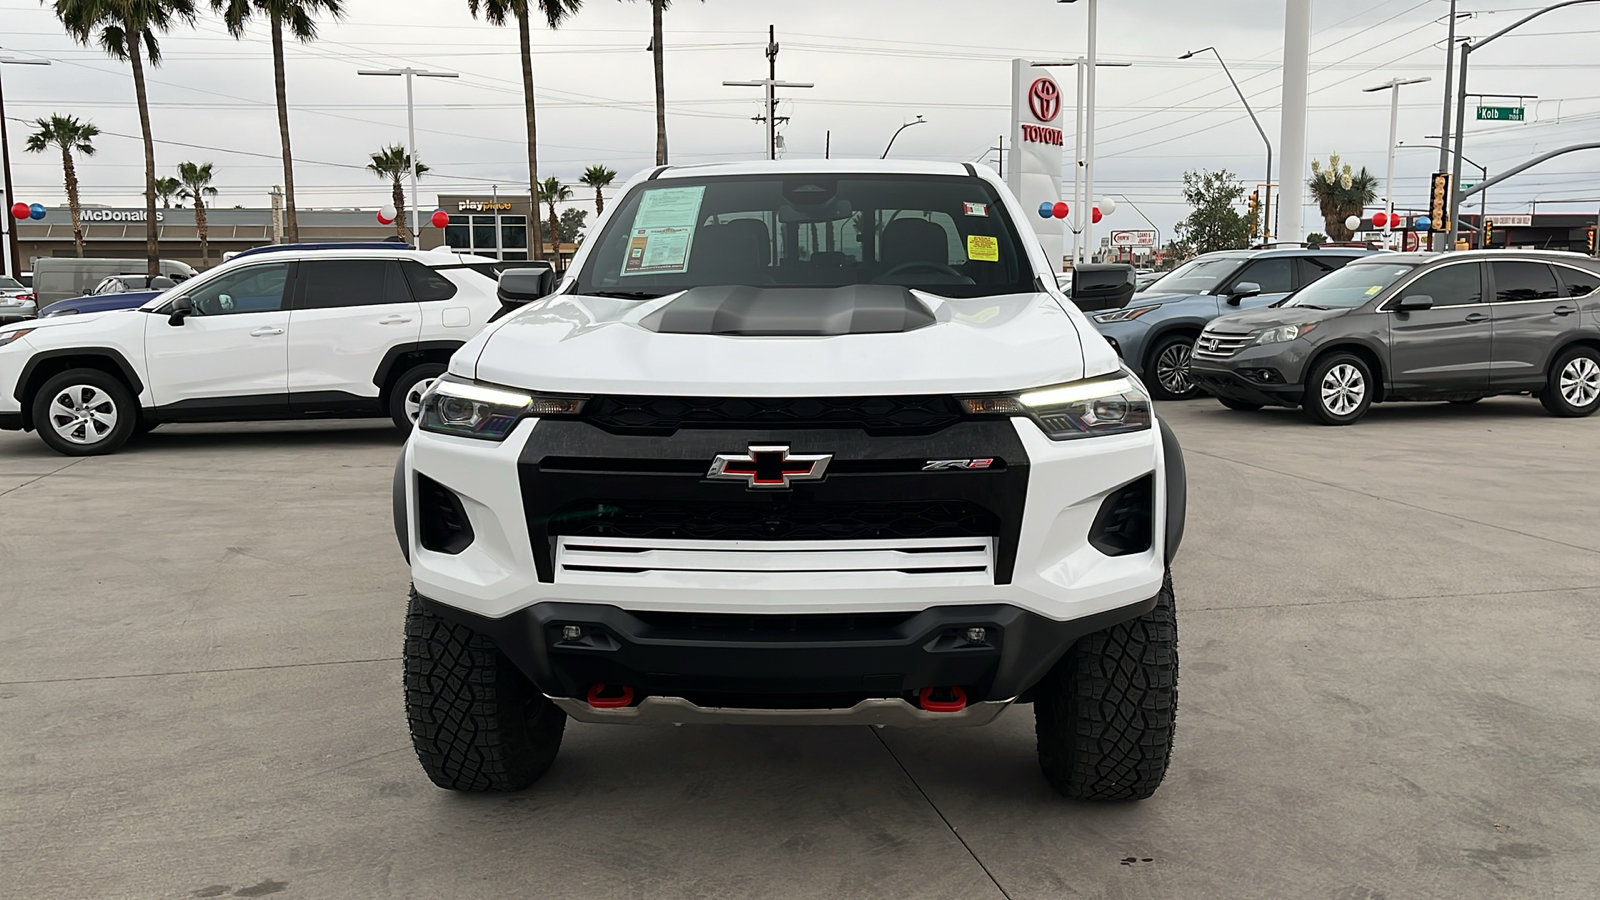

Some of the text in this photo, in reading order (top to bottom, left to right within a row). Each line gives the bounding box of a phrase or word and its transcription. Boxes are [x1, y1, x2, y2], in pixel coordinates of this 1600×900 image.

[1481, 108, 1499, 119] Kolb
[1021, 124, 1064, 147] TOYOTA
[458, 200, 512, 211] playplace
[80, 210, 164, 221] McDonals
[921, 459, 993, 470] ZR2
